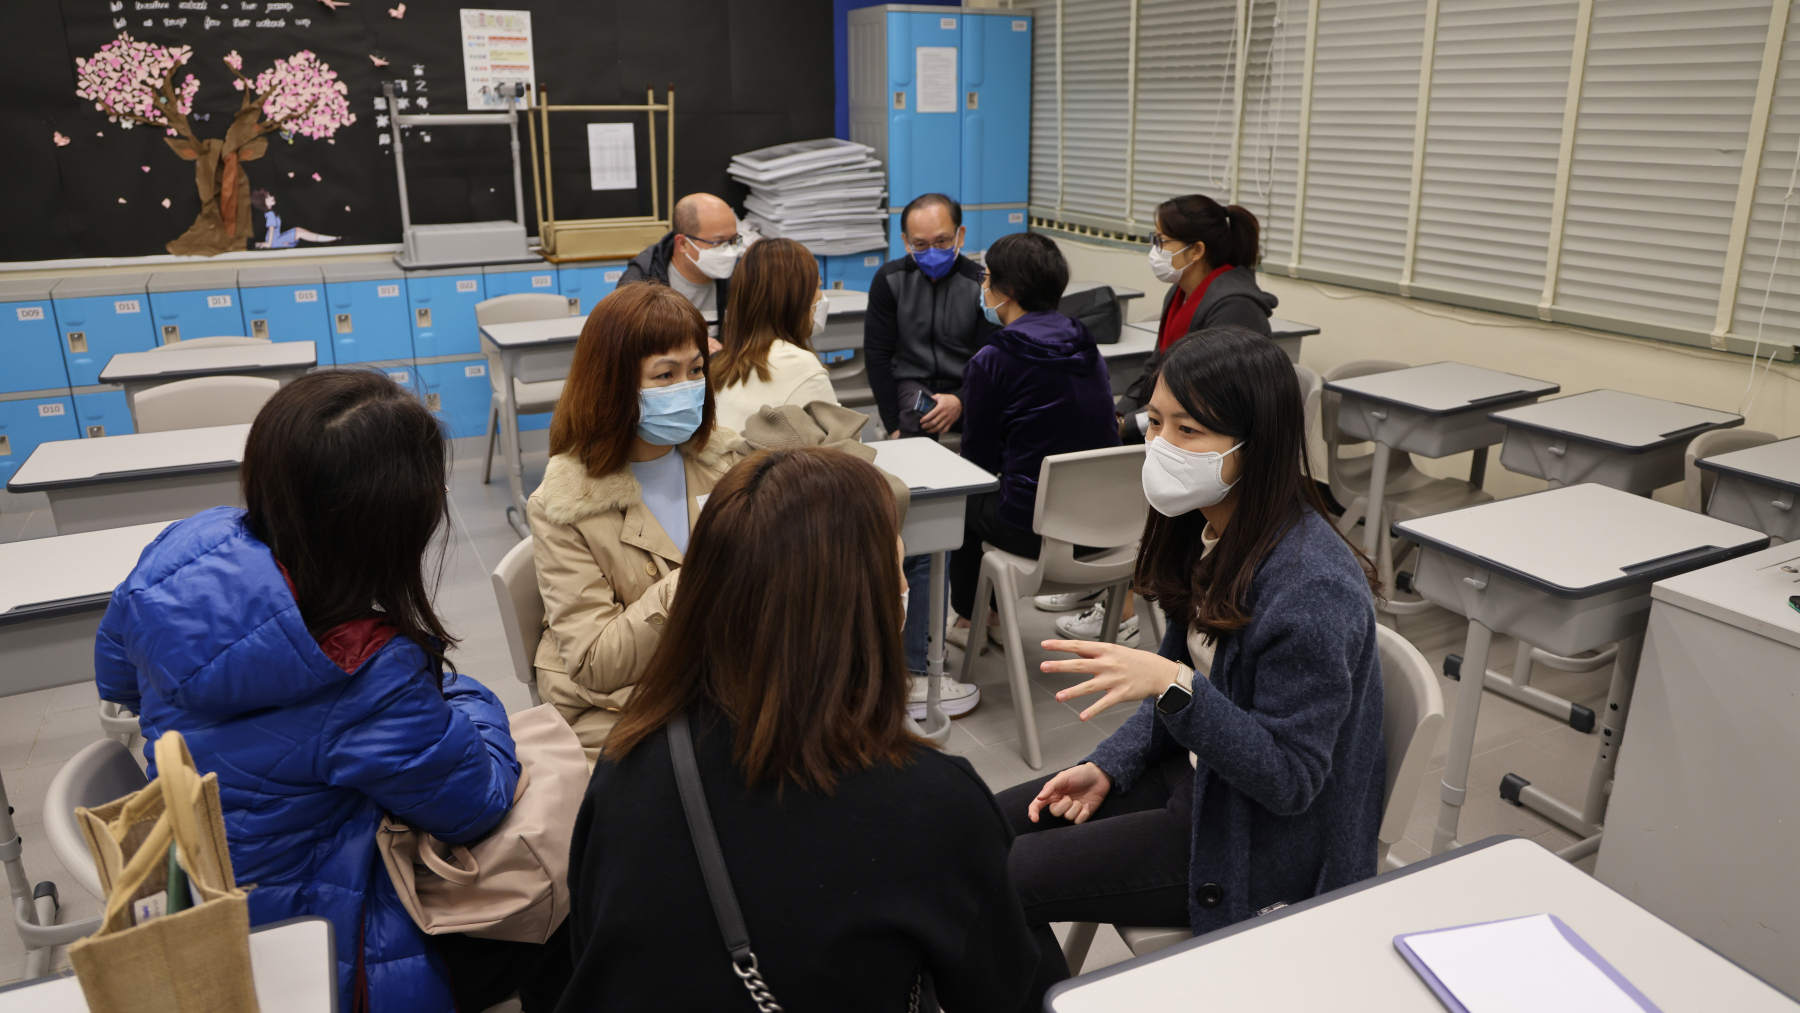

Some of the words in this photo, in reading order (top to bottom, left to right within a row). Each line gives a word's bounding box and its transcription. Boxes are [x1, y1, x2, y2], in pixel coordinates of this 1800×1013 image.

[298, 291, 314, 300] D15
[212, 296, 227, 305] D13
[118, 302, 136, 311] D11
[21, 309, 40, 318] D09
[42, 405, 61, 414] D10
